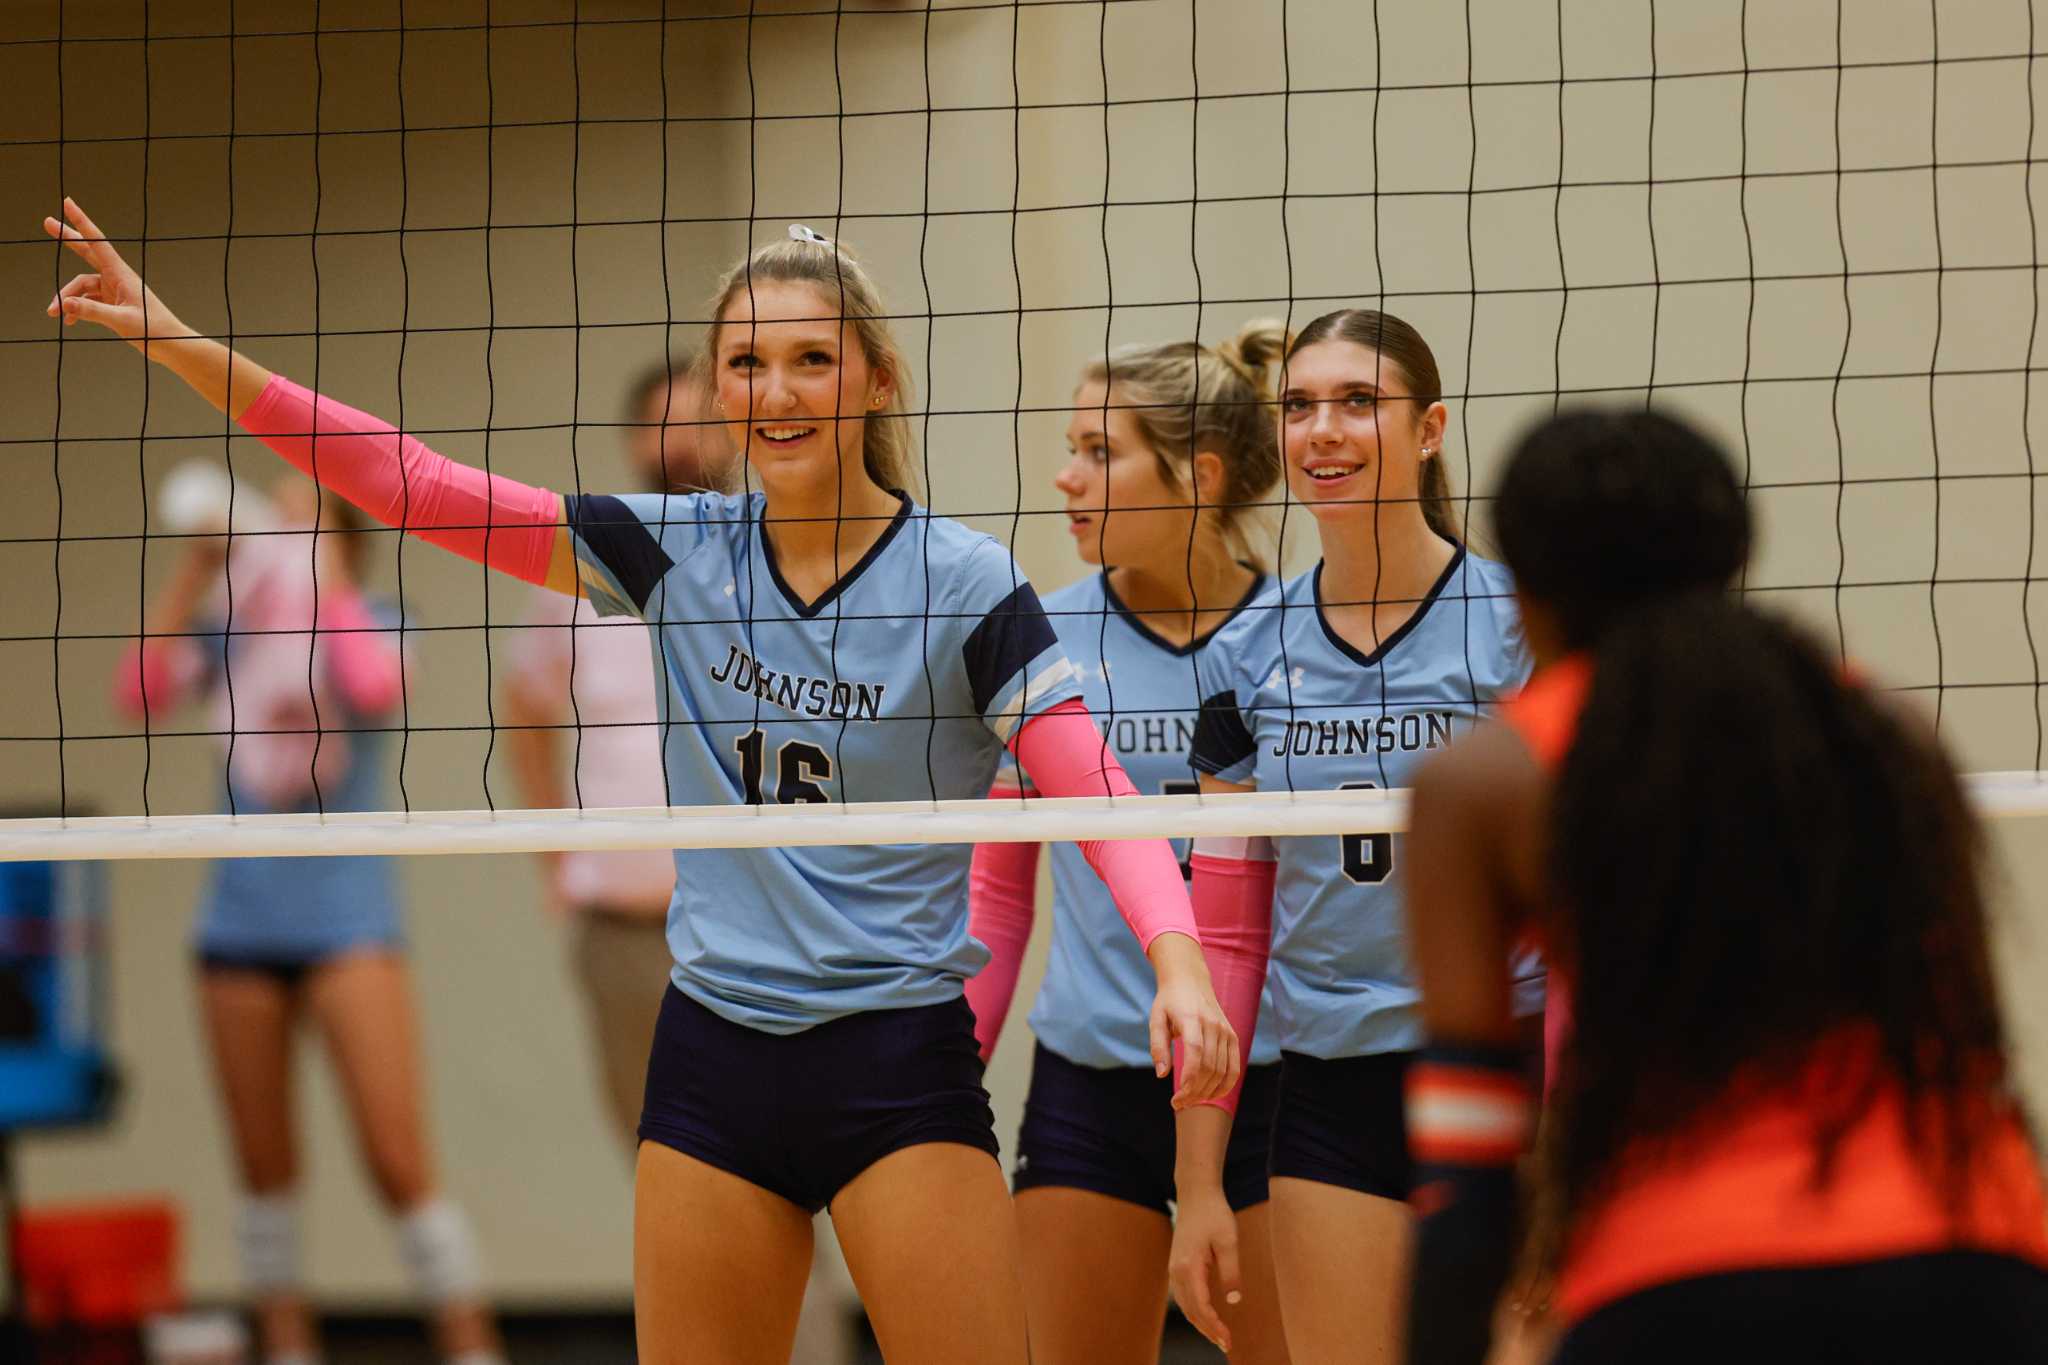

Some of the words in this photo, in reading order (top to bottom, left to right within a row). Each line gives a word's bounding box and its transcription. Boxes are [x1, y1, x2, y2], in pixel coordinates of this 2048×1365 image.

[710, 643, 886, 724] JOHNSON
[734, 727, 833, 804] 16
[1273, 711, 1453, 757] JOHNSON
